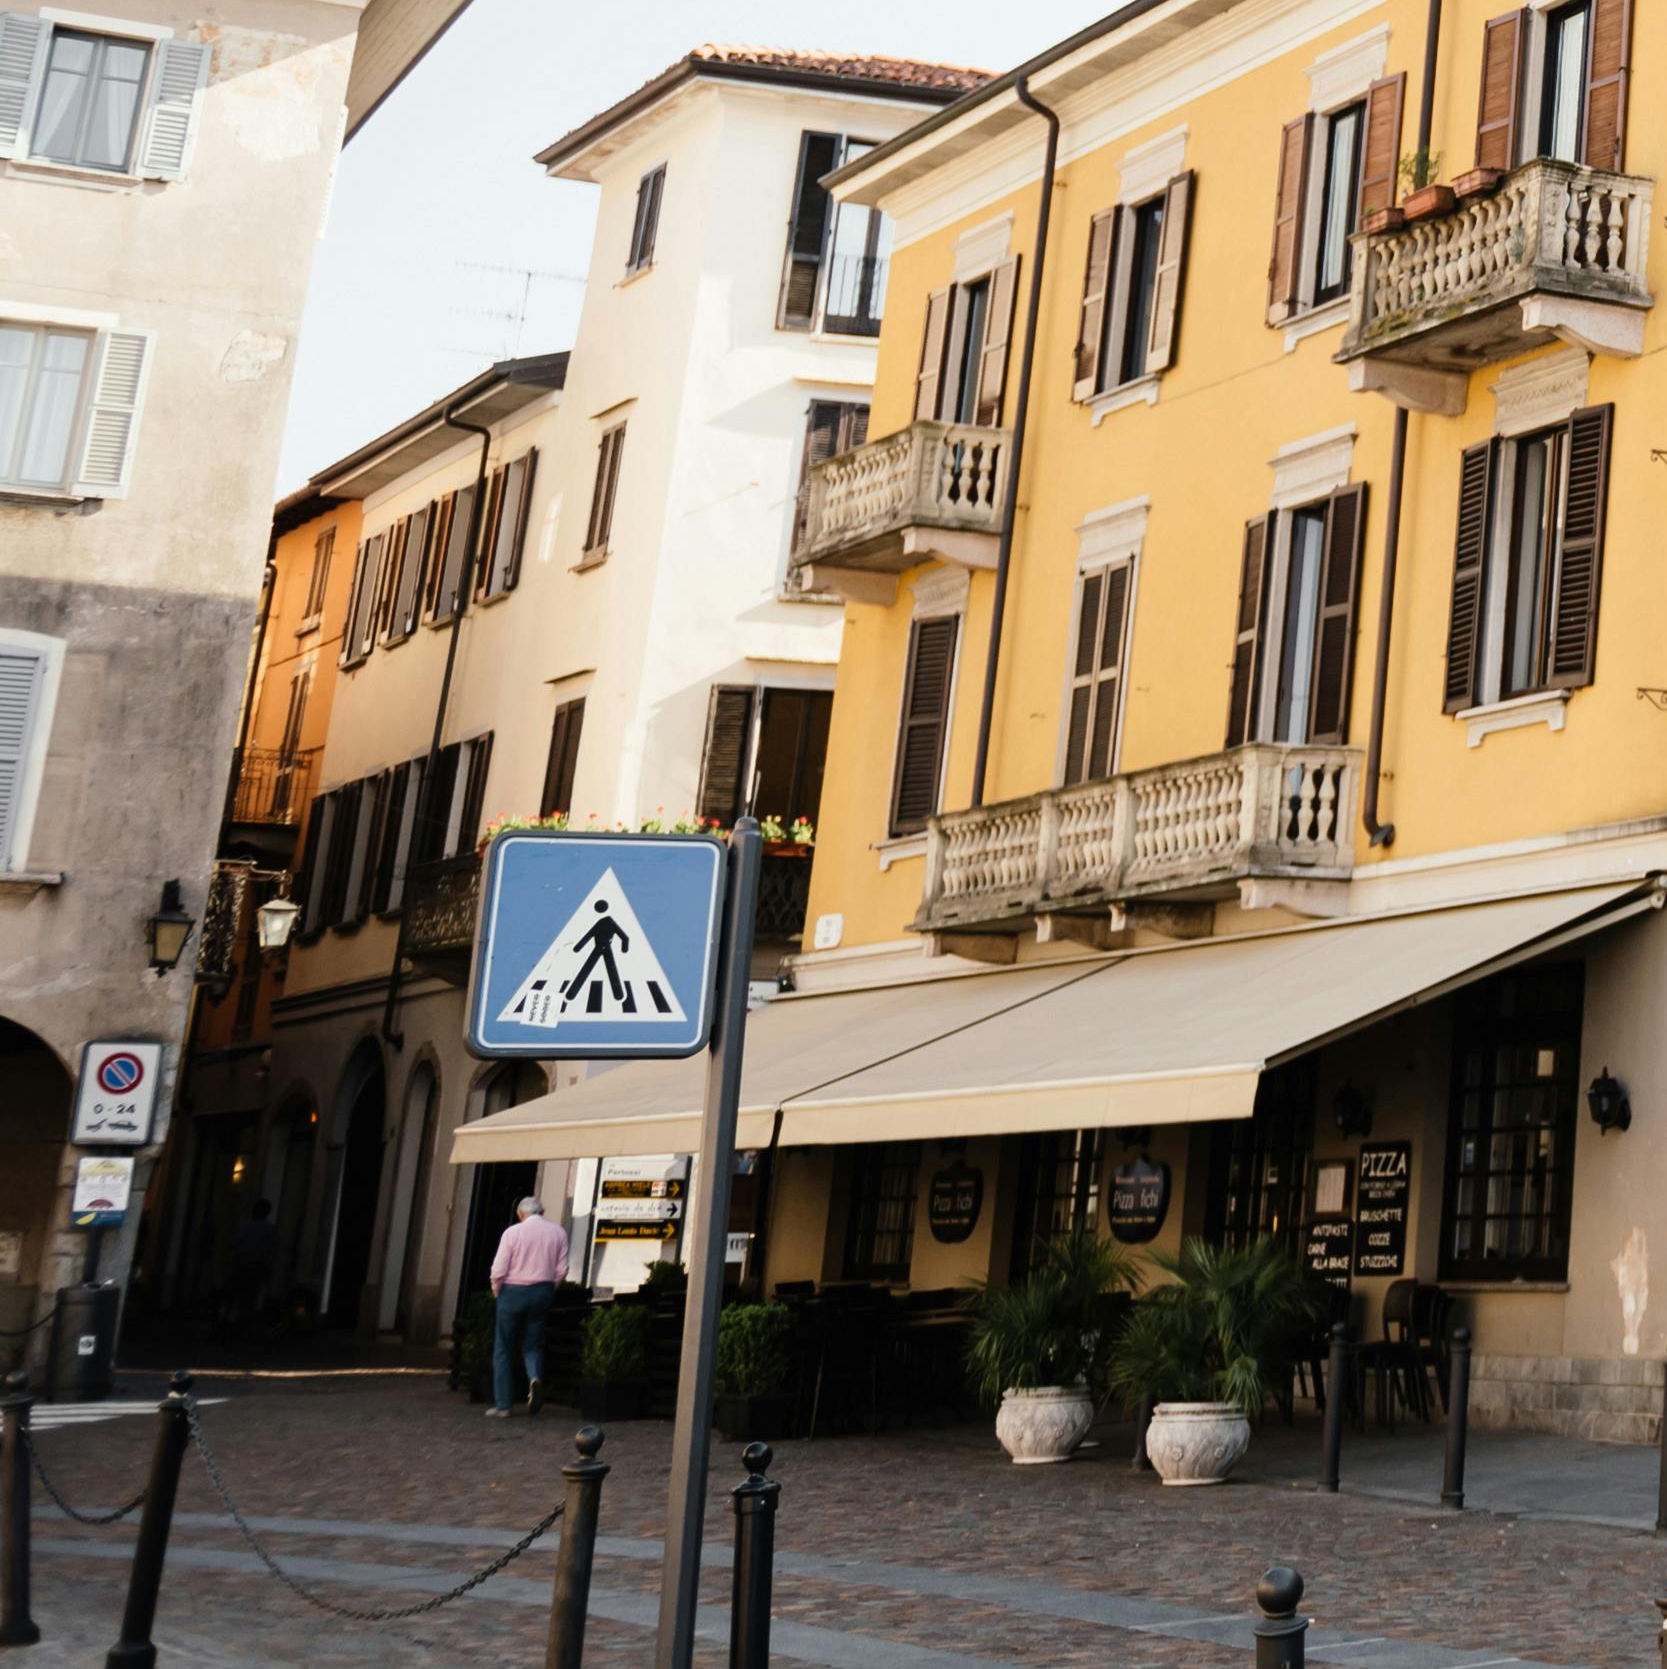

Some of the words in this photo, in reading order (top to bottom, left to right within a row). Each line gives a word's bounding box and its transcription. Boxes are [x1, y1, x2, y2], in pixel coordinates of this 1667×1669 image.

[93, 1104, 103, 1114] 0
[117, 1103, 136, 1114] 24
[1360, 1151, 1407, 1177] PIZZA
[1113, 1191, 1135, 1211] Pizza
[1360, 1207, 1403, 1223] BRUSCHETTE
[1312, 1224, 1349, 1237] ANTIPASTI
[1368, 1232, 1390, 1246] COZZE
[1312, 1257, 1328, 1270] ALLA
[1329, 1256, 1349, 1269] BRACE
